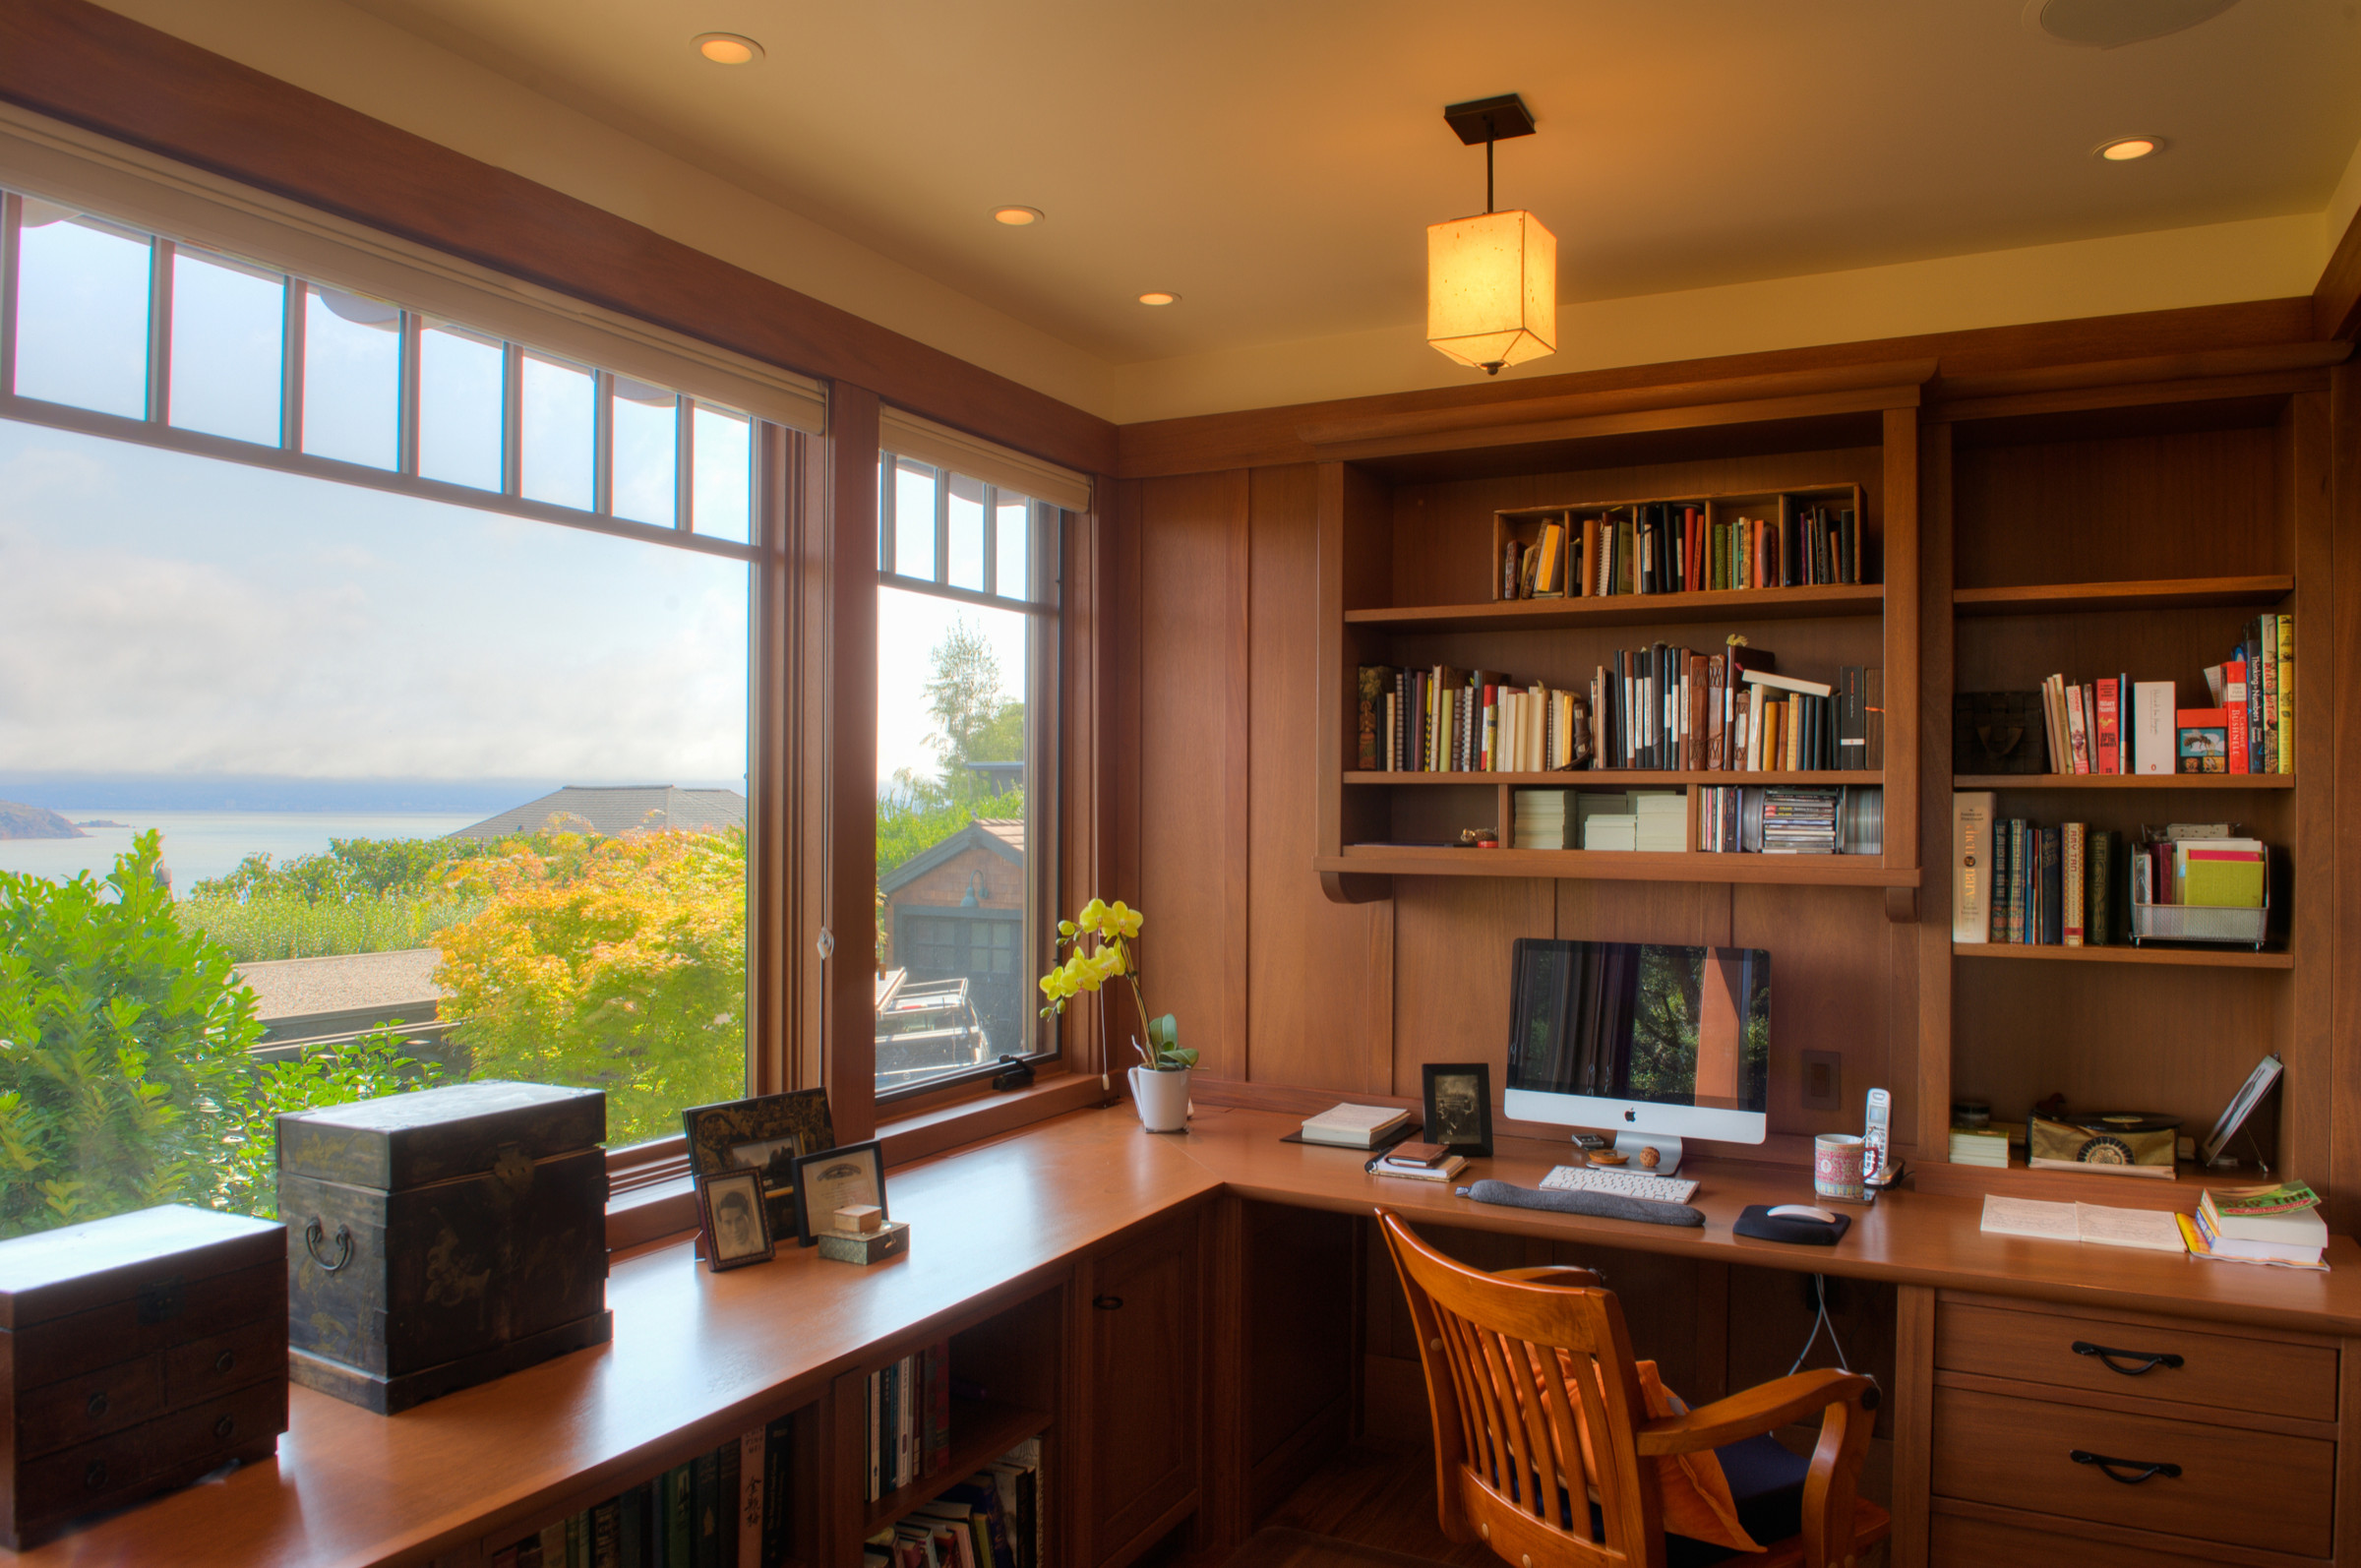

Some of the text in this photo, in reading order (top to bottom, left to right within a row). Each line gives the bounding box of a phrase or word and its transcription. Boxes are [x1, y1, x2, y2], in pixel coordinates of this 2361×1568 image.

[2251, 656, 2261, 721] Thinking Numbers
[2266, 694, 2276, 724] NATURE
[2231, 709, 2240, 755] BUSHNELL
[1965, 824, 1980, 900] dictionary
[2272, 1189, 2311, 1205] TAN
